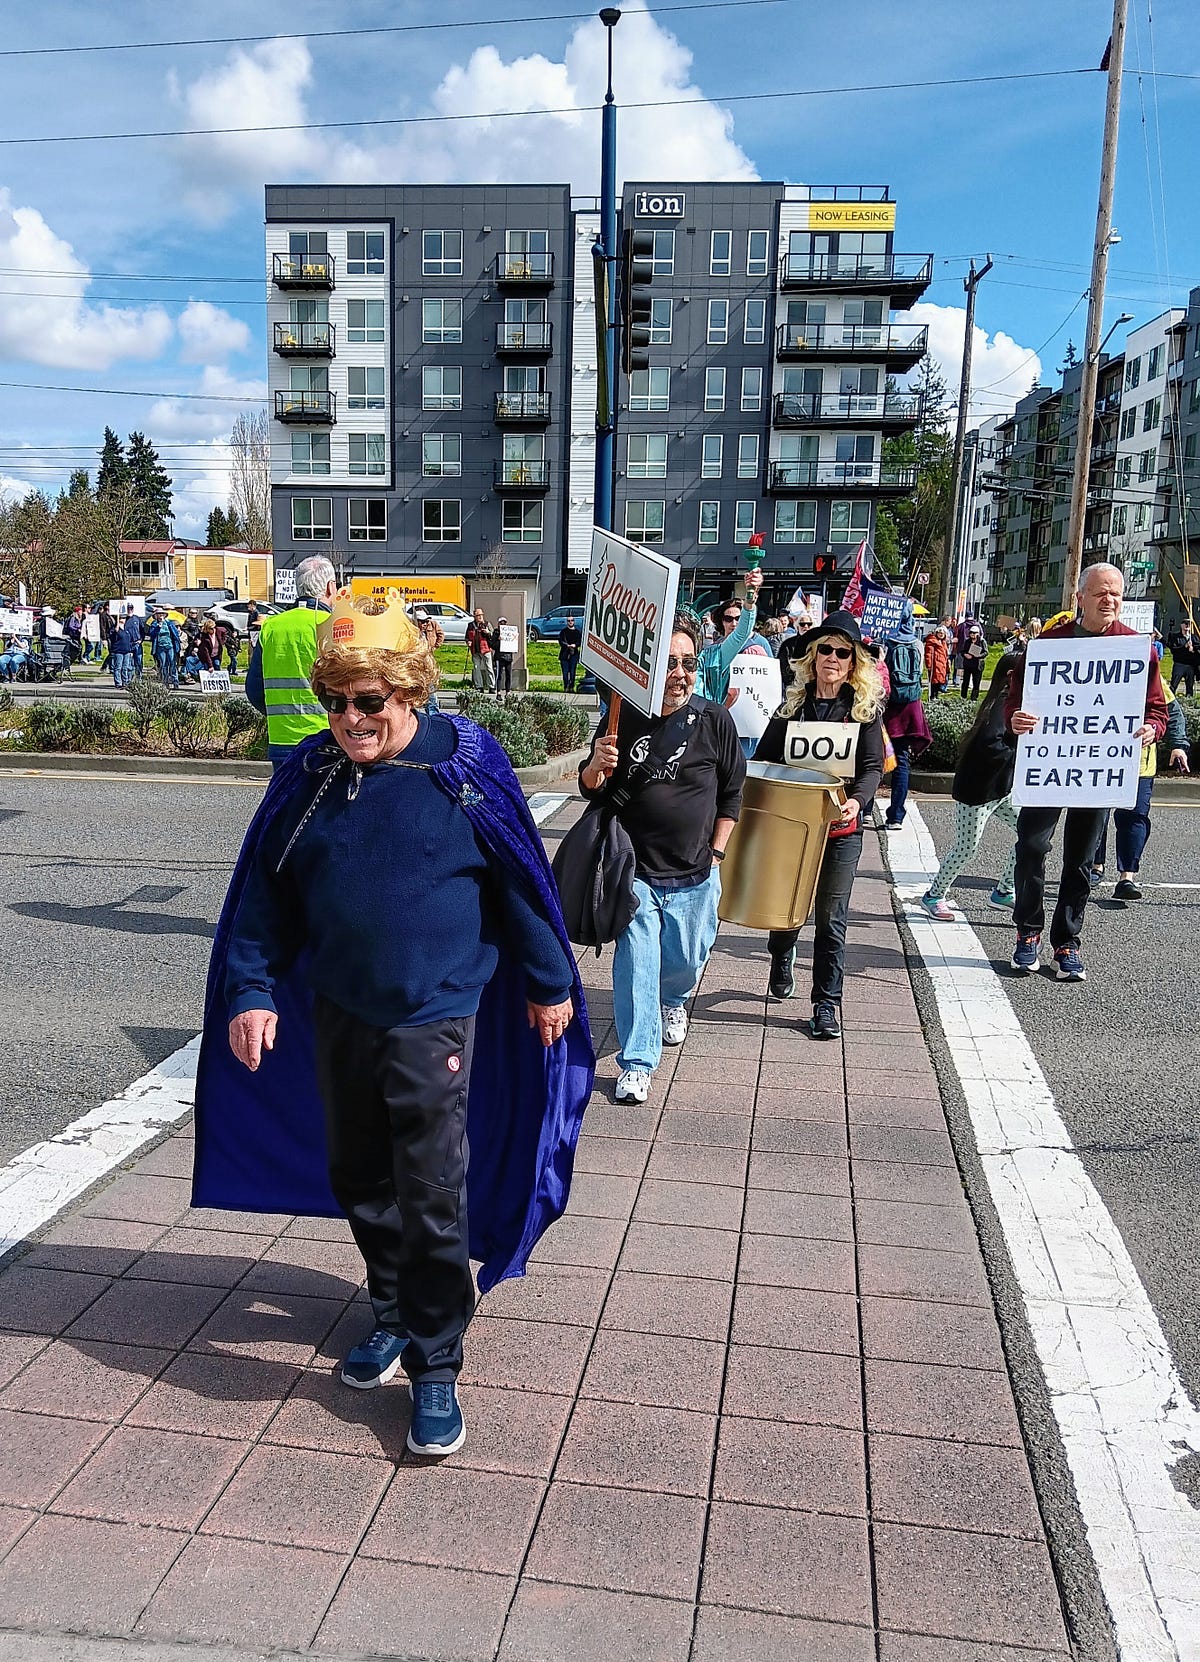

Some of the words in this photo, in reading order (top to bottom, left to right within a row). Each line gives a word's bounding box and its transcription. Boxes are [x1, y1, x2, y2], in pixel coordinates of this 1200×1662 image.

[640, 191, 681, 214] ion
[815, 211, 844, 221] NOW
[845, 211, 889, 221] LEASING
[276, 570, 297, 579] RULE
[372, 587, 385, 595] J&R
[404, 586, 428, 595] Rentals
[601, 562, 658, 634] Danica
[868, 595, 887, 607] HATE
[887, 598, 904, 610] WILL
[865, 606, 881, 617] NOT
[881, 608, 903, 620] MAKE
[863, 615, 876, 625] US
[875, 617, 900, 630] GREAT
[333, 629, 354, 639] KING
[589, 592, 656, 673] NOBLE
[732, 666, 745, 675] BY
[749, 666, 769, 676] THE
[1028, 659, 1145, 686] TRUMP
[1057, 694, 1075, 707] IS
[1093, 693, 1105, 706] A
[1029, 715, 1140, 735] HREAT
[790, 736, 853, 761] DOJ
[1025, 745, 1049, 758] TO
[1057, 745, 1100, 758] LIFE
[1107, 745, 1133, 758] ON
[1025, 767, 1125, 787] EARTH
